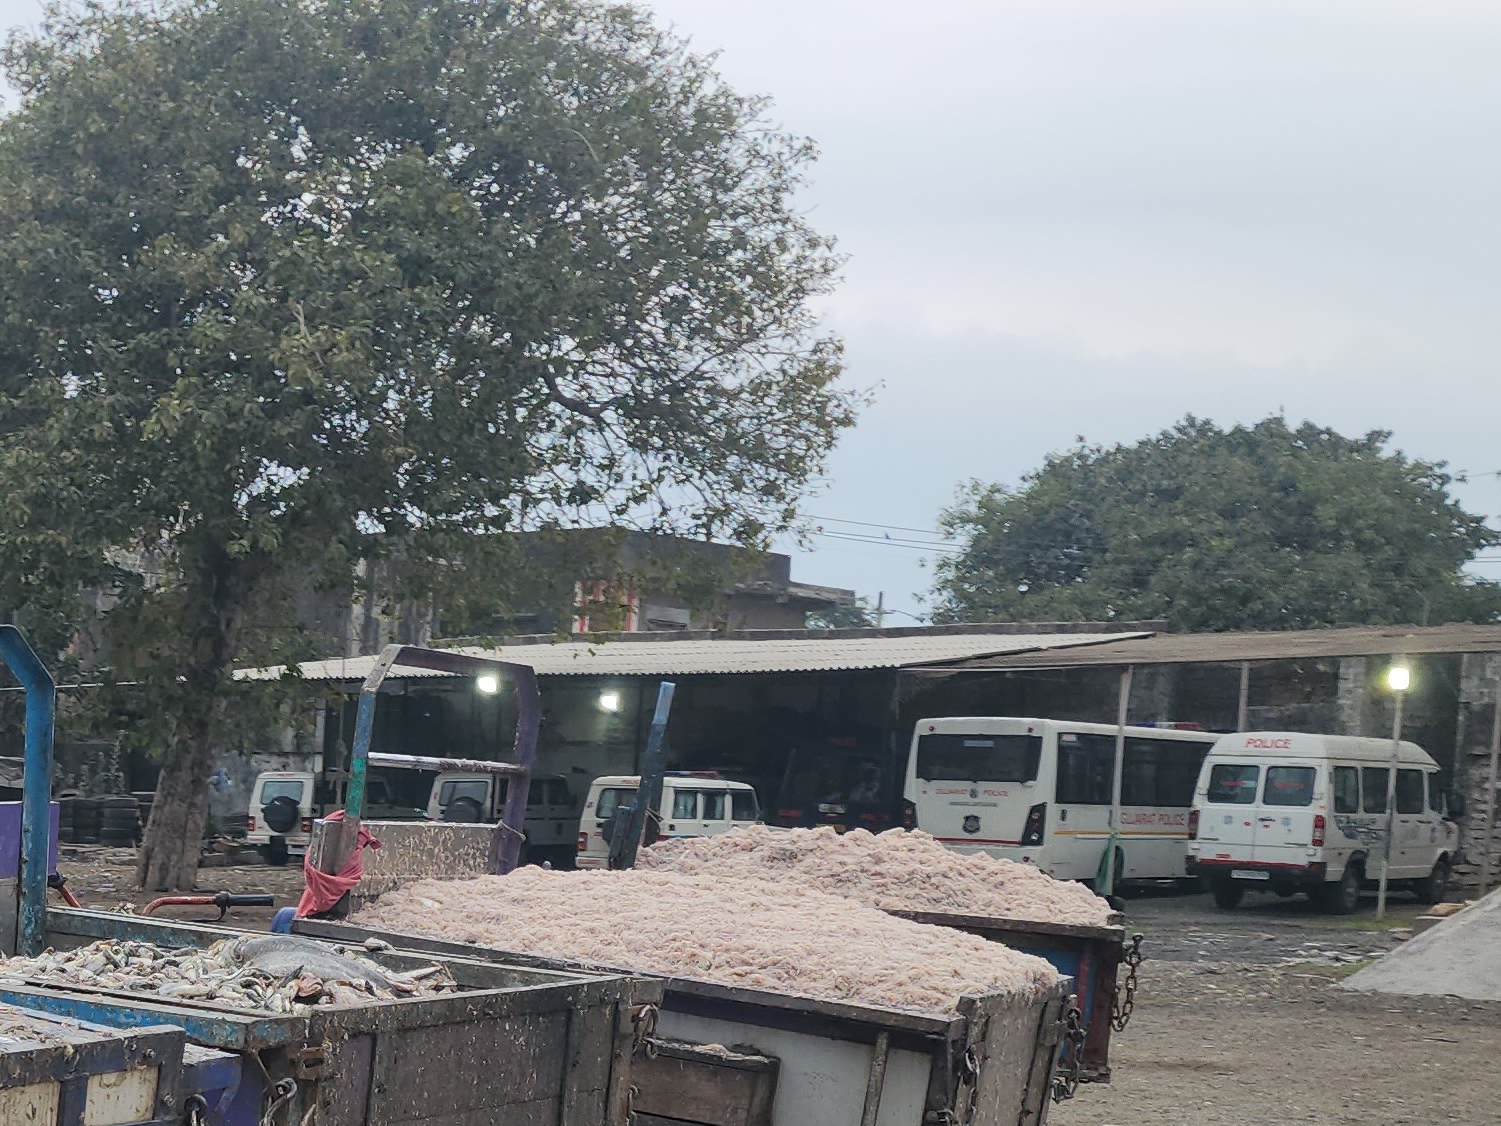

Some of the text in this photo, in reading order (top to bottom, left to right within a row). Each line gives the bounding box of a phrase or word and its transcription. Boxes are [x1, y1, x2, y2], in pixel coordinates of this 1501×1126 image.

[1245, 738, 1291, 749] POLICE
[983, 789, 1009, 797] POLICE
[1158, 813, 1185, 826] POLICE
